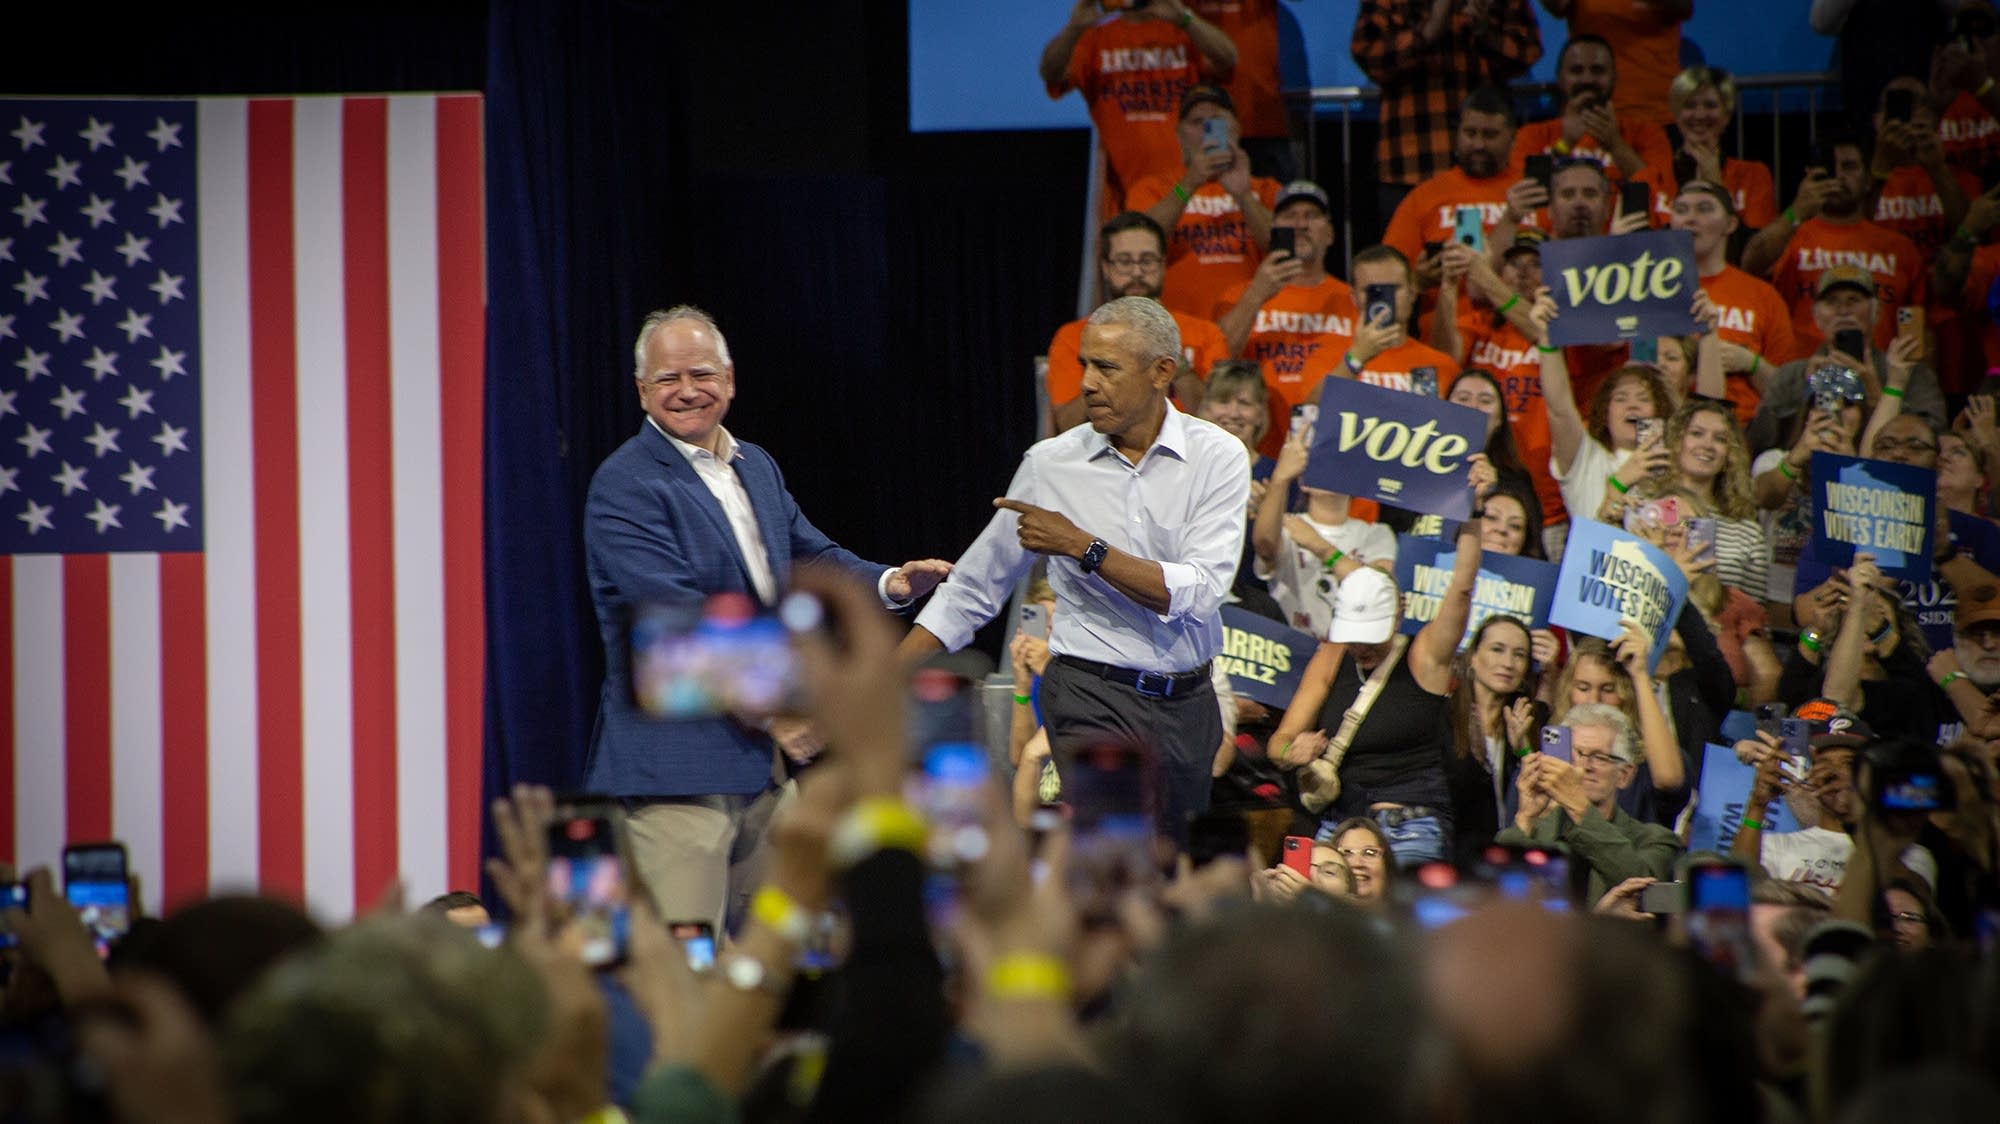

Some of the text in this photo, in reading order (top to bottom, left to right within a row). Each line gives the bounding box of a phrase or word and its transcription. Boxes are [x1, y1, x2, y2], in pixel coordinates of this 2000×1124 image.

[1873, 193, 1945, 222] IUNA
[1175, 222, 1249, 243] HARRI
[1561, 250, 1682, 309] vote
[1504, 377, 1543, 399] RIS
[1337, 411, 1470, 475] vote
[1825, 481, 1926, 525] WISCONSIN
[1823, 509, 1871, 546] VOTES
[1873, 520, 1927, 556] EARLY
[1413, 564, 1536, 616] WISONSIN
[1578, 575, 1640, 618] VOTES
[1899, 578, 1960, 608] 202
[1222, 625, 1292, 673] ARRIS
